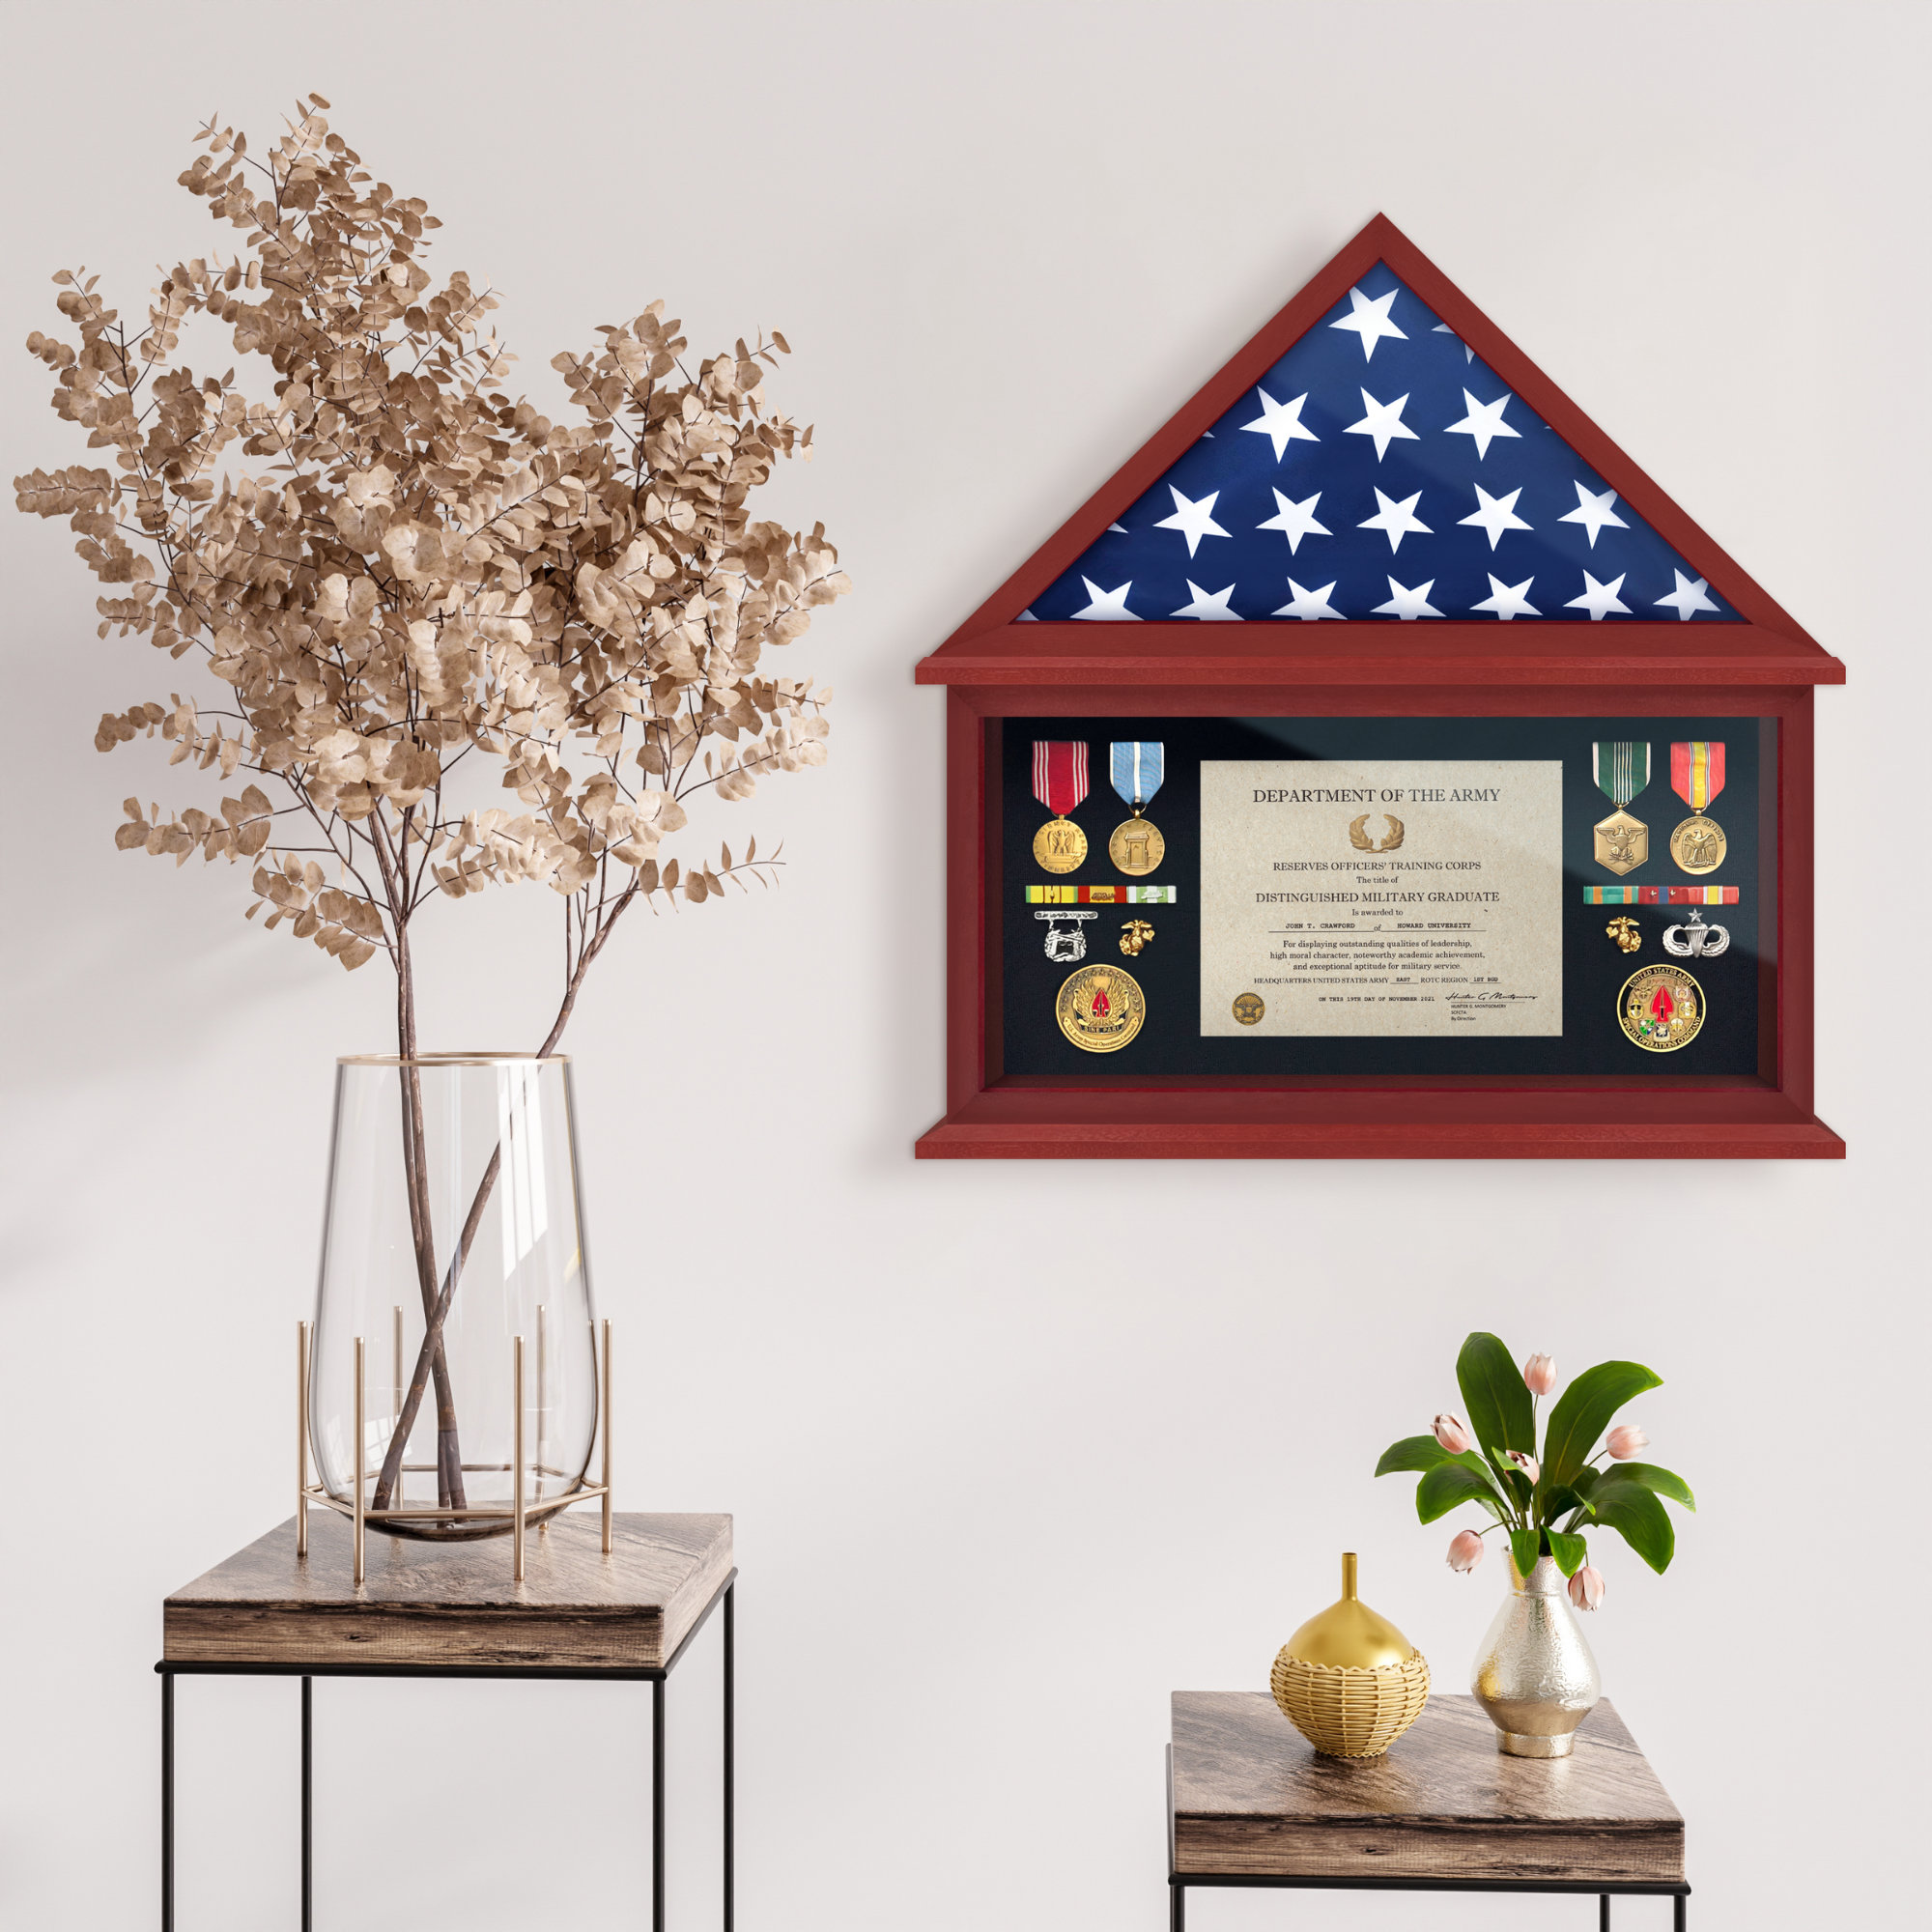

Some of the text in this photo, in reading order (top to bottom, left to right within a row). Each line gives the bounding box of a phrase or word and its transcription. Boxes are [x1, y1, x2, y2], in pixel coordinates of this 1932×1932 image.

[1253, 788, 1501, 803] DEPARTMENT OF THE ARMY
[1273, 862, 1482, 871] RESERVES OFFICERS' TRAINING CORPS
[1256, 892, 1500, 903] DISTINGUISHED MILITARY GRADUATE
[1298, 940, 1338, 949] displaying
[1339, 940, 1385, 949] outstanding
[1269, 952, 1288, 960] high
[1401, 962, 1433, 971] military
[1629, 969, 1653, 987] UNITED
[1677, 970, 1695, 987] ARMY
